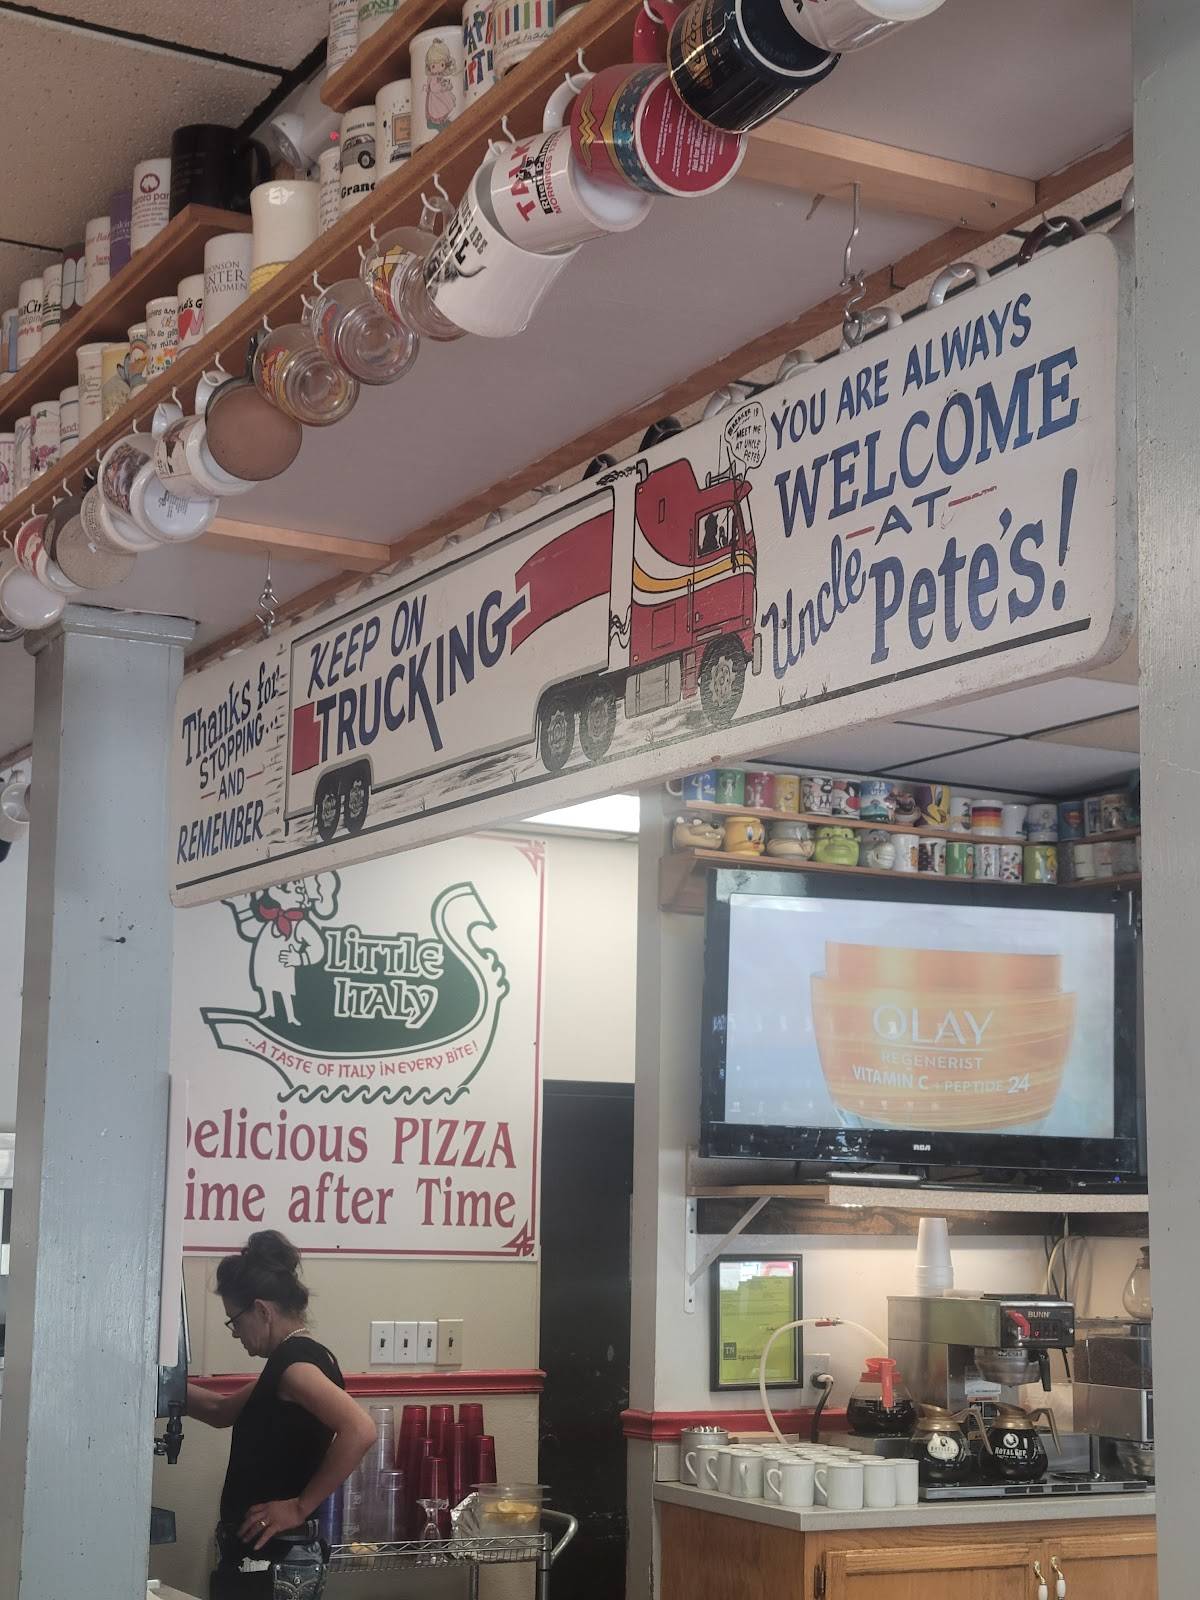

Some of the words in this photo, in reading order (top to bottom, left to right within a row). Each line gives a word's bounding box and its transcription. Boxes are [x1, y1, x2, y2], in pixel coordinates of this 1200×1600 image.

[208, 269, 247, 285] NTER
[770, 388, 826, 450] YOU
[837, 359, 889, 424] ARE
[902, 292, 1032, 397] ALWAYS
[735, 440, 743, 451] AT
[744, 439, 761, 450] UNCLE
[736, 425, 751, 438] MEET
[753, 424, 761, 435] ME
[774, 346, 1080, 538] WELCOME
[875, 485, 951, 545] AT
[761, 534, 866, 680] Uncle
[869, 467, 1078, 665] Pete's!
[307, 616, 381, 698] KEEP
[391, 594, 427, 657] ON
[316, 589, 526, 763] TRUCKING
[182, 679, 250, 767] Thanks
[257, 661, 280, 711] for
[218, 767, 245, 801] AND
[176, 799, 264, 864] REMEMBER
[872, 1004, 994, 1045] OLAY
[270, 1045, 312, 1075] TASTE
[317, 1062, 334, 1077] OF
[338, 1062, 376, 1079] ITALY
[398, 1051, 443, 1074] EVERY
[853, 1063, 913, 1090] VITAMIN
[918, 1075, 930, 1091] C
[944, 1079, 1003, 1093] PEPTIDE
[1007, 1072, 1032, 1095] 24
[880, 1053, 984, 1071] REGENERIST
[391, 1116, 517, 1169] PIZZA
[913, 1143, 931, 1152] RCA
[183, 1167, 266, 1222] ime
[287, 1171, 395, 1225] after
[416, 1176, 517, 1228] Time
[1027, 1310, 1051, 1319] BUNN
